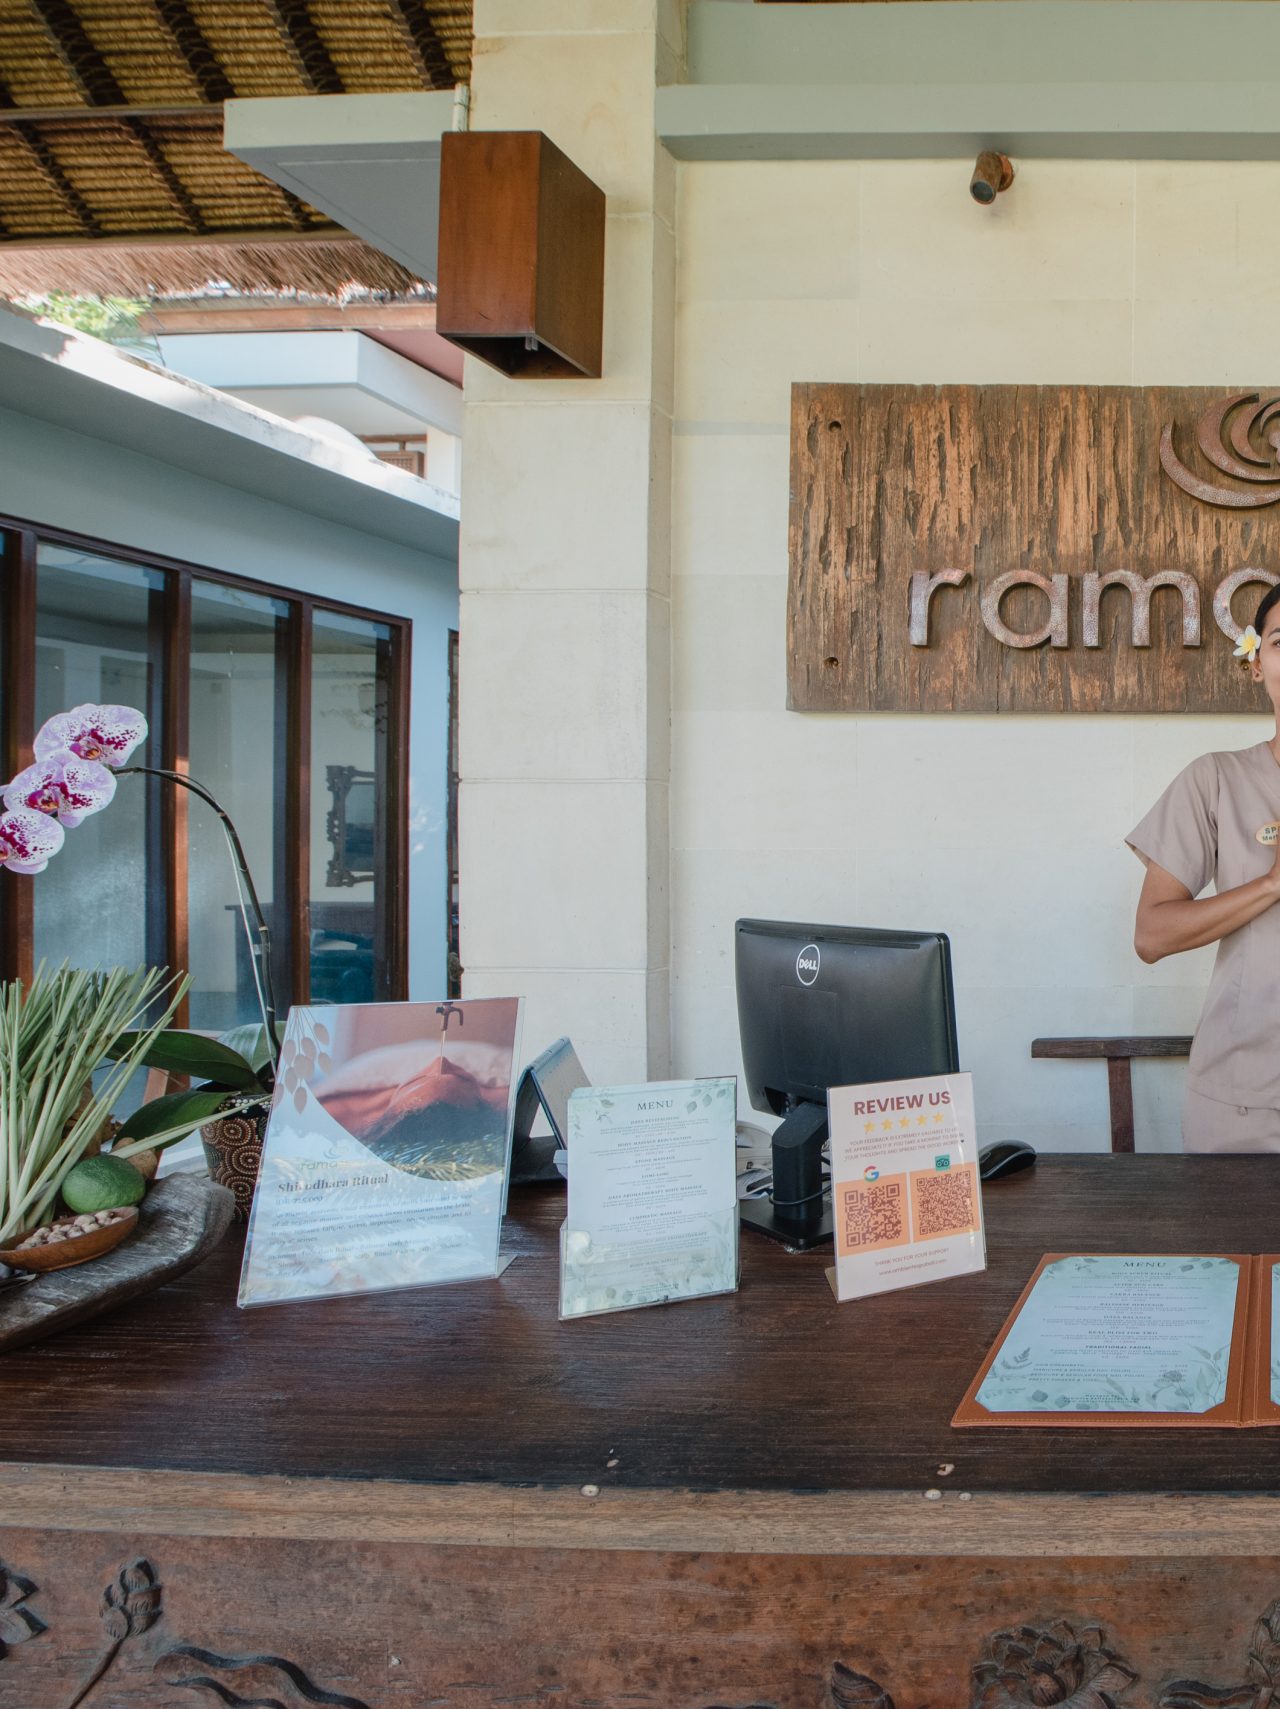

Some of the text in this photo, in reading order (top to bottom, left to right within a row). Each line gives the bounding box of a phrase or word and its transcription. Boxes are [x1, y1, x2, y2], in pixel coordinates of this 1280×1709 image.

[799, 958, 817, 970] DELL
[637, 1100, 673, 1111] MENU
[854, 1091, 950, 1116] REVIEW US
[352, 1174, 389, 1186] Ritual
